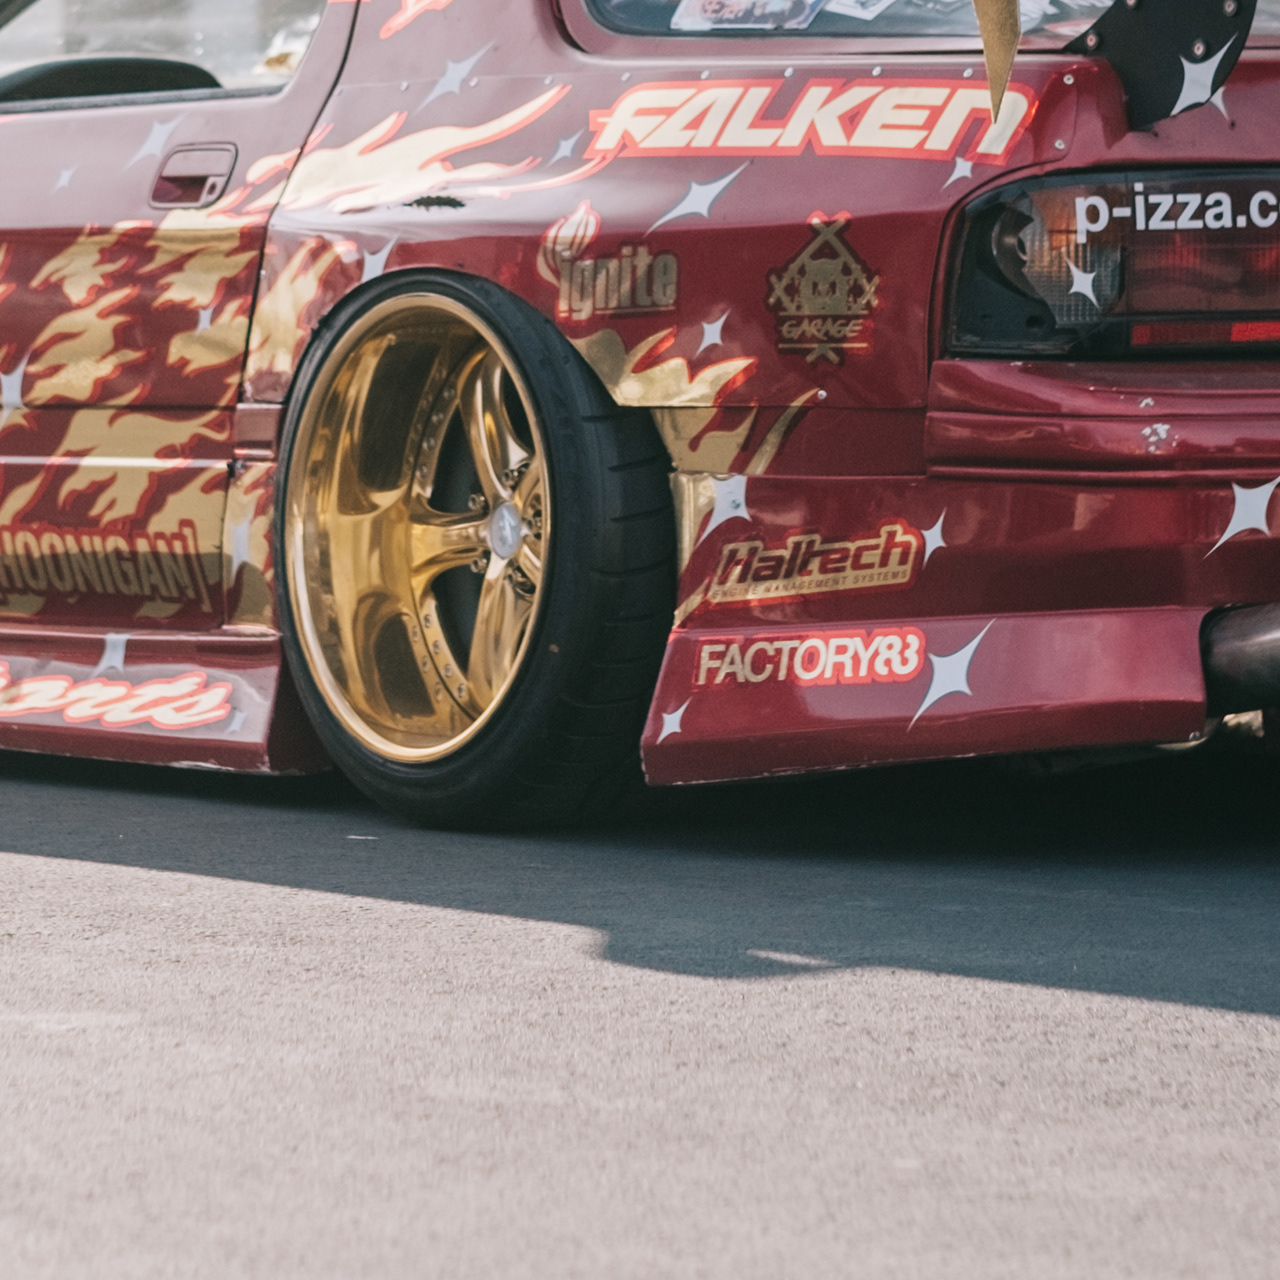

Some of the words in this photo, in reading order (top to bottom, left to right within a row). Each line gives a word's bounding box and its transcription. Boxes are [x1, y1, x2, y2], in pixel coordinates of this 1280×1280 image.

[595, 86, 1028, 154] FALKEN
[781, 317, 864, 340] GARAGE
[716, 531, 913, 586] Haltech
[763, 572, 848, 594] MANAGEMENT
[852, 562, 910, 584] SYSTEMS
[696, 634, 919, 686] FACTORY83
